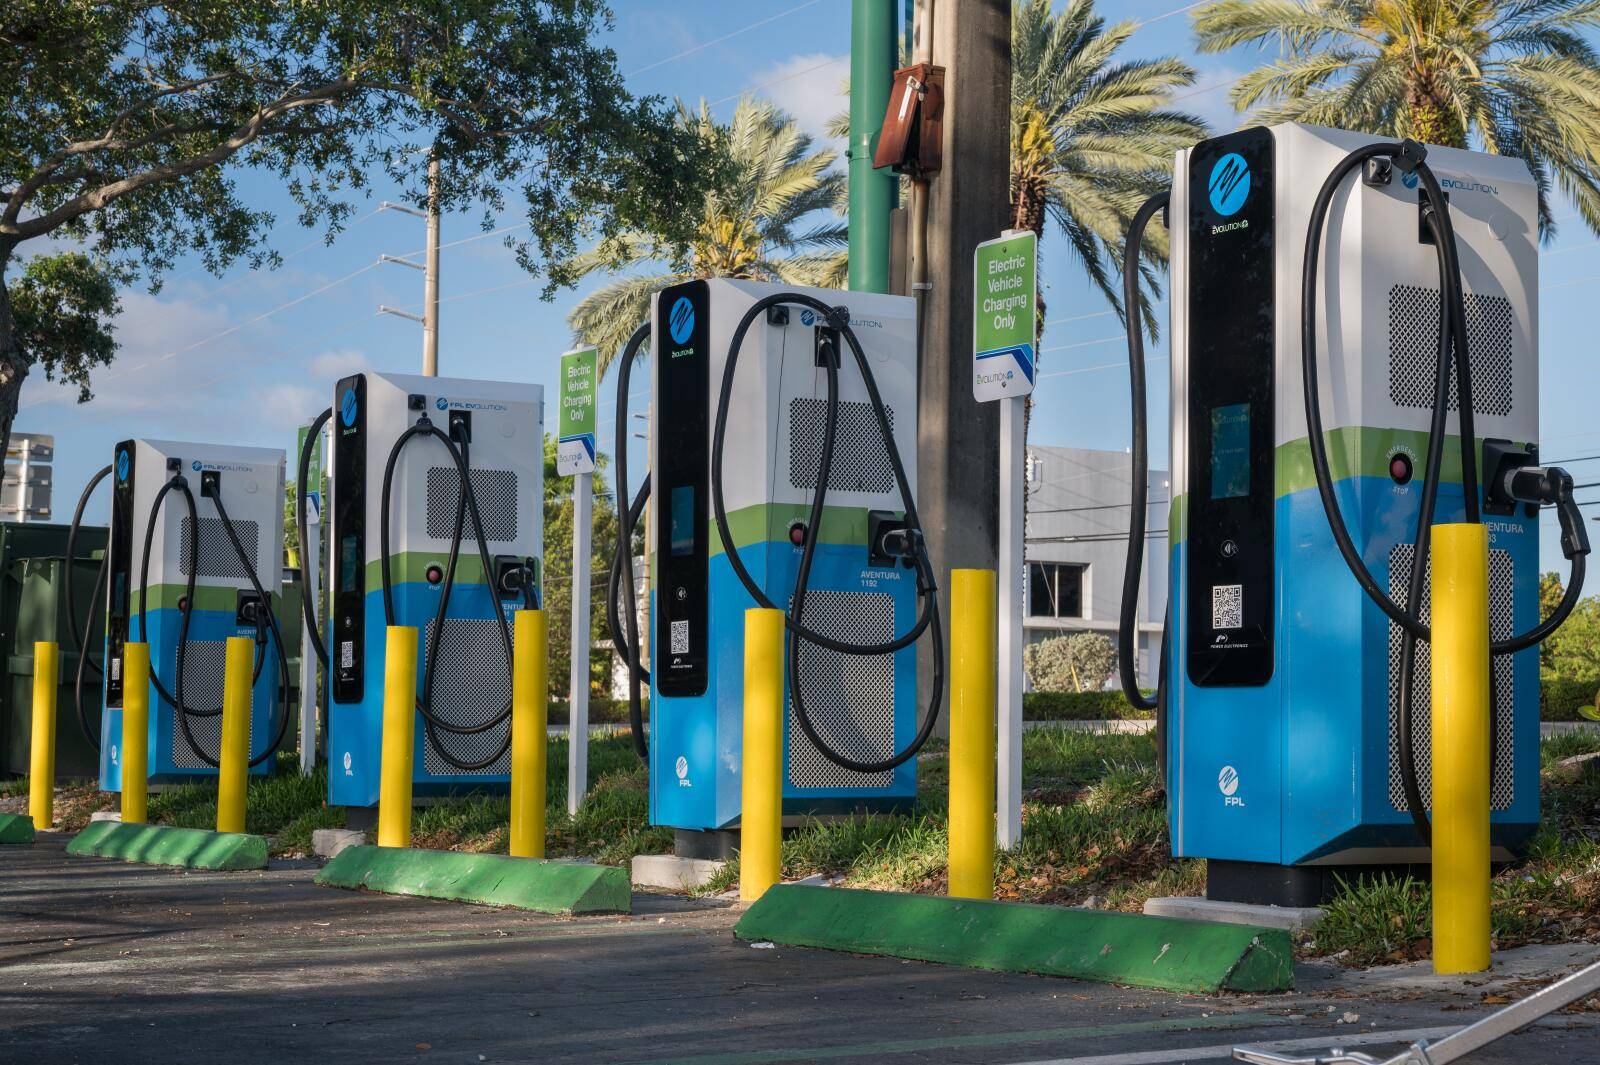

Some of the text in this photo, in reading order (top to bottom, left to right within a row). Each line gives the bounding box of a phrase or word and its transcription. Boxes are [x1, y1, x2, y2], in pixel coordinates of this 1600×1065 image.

[1442, 179, 1497, 195] EVOLUTION
[988, 255, 1026, 275] Electric
[988, 274, 1023, 293] Vehicle
[983, 294, 1027, 313] Charging
[993, 313, 1016, 330] Only
[568, 364, 591, 378] Electric
[567, 379, 589, 393] Vehicle
[563, 394, 592, 408] Charging
[570, 409, 585, 422] Only
[861, 571, 900, 580] AVENTURA
[861, 580, 878, 588] 1192
[679, 779, 692, 787] FPL
[1225, 797, 1246, 807] FPL
